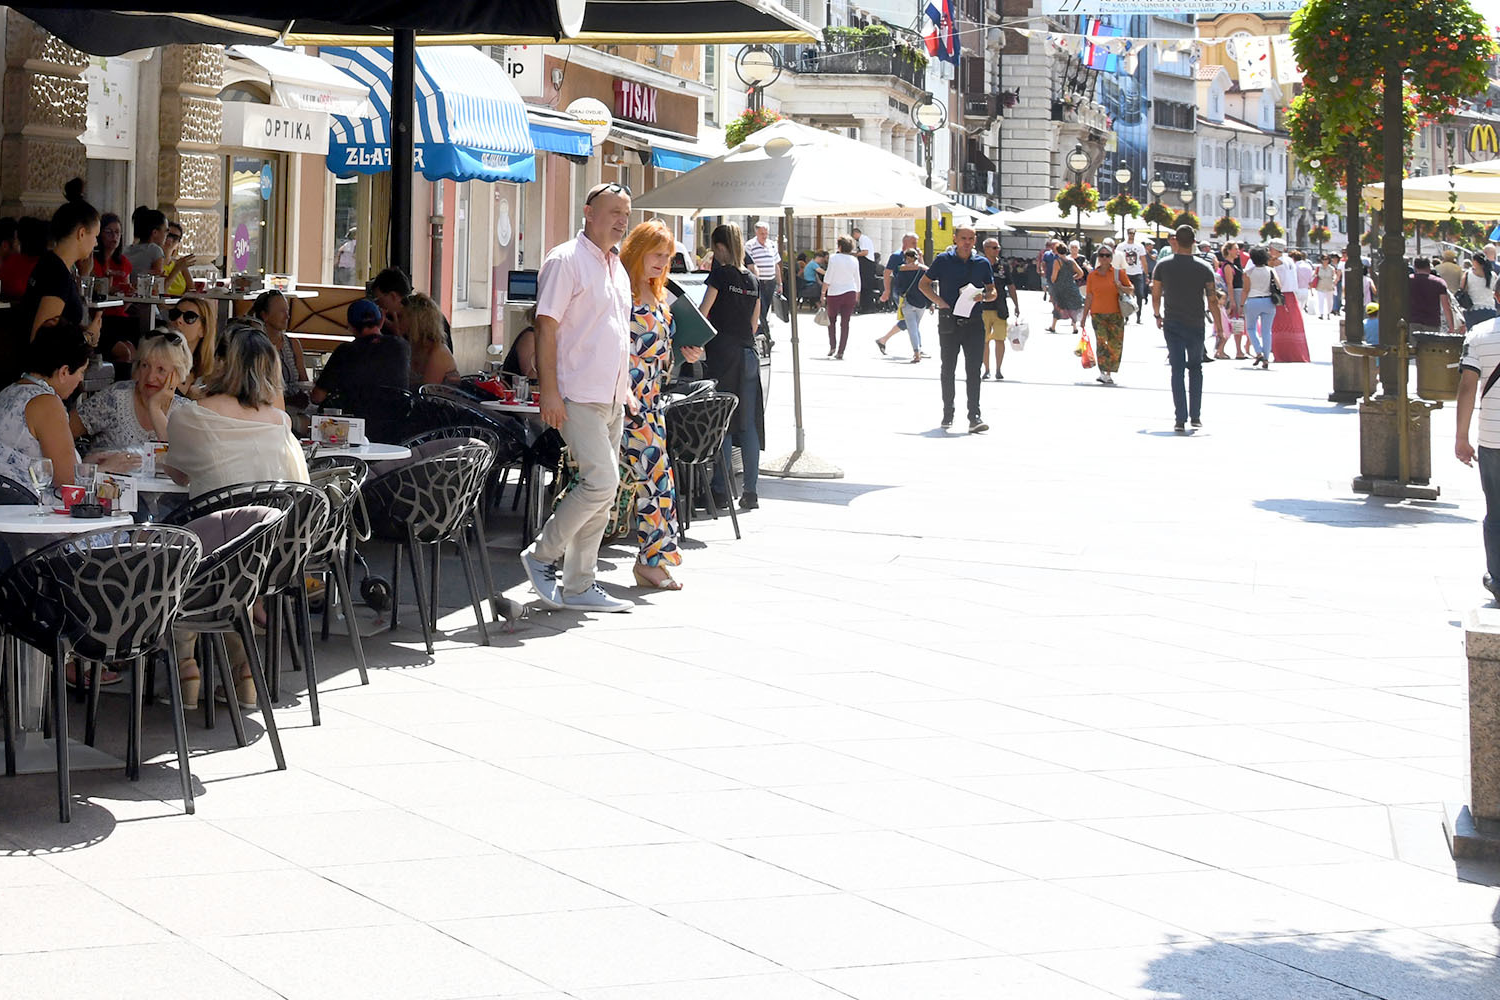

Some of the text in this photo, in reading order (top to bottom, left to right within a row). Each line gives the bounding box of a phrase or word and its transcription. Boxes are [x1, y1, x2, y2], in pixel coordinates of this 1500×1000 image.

[621, 80, 658, 123] TISAK
[265, 118, 311, 141] OPTIKA
[345, 147, 426, 169] ZLATR
